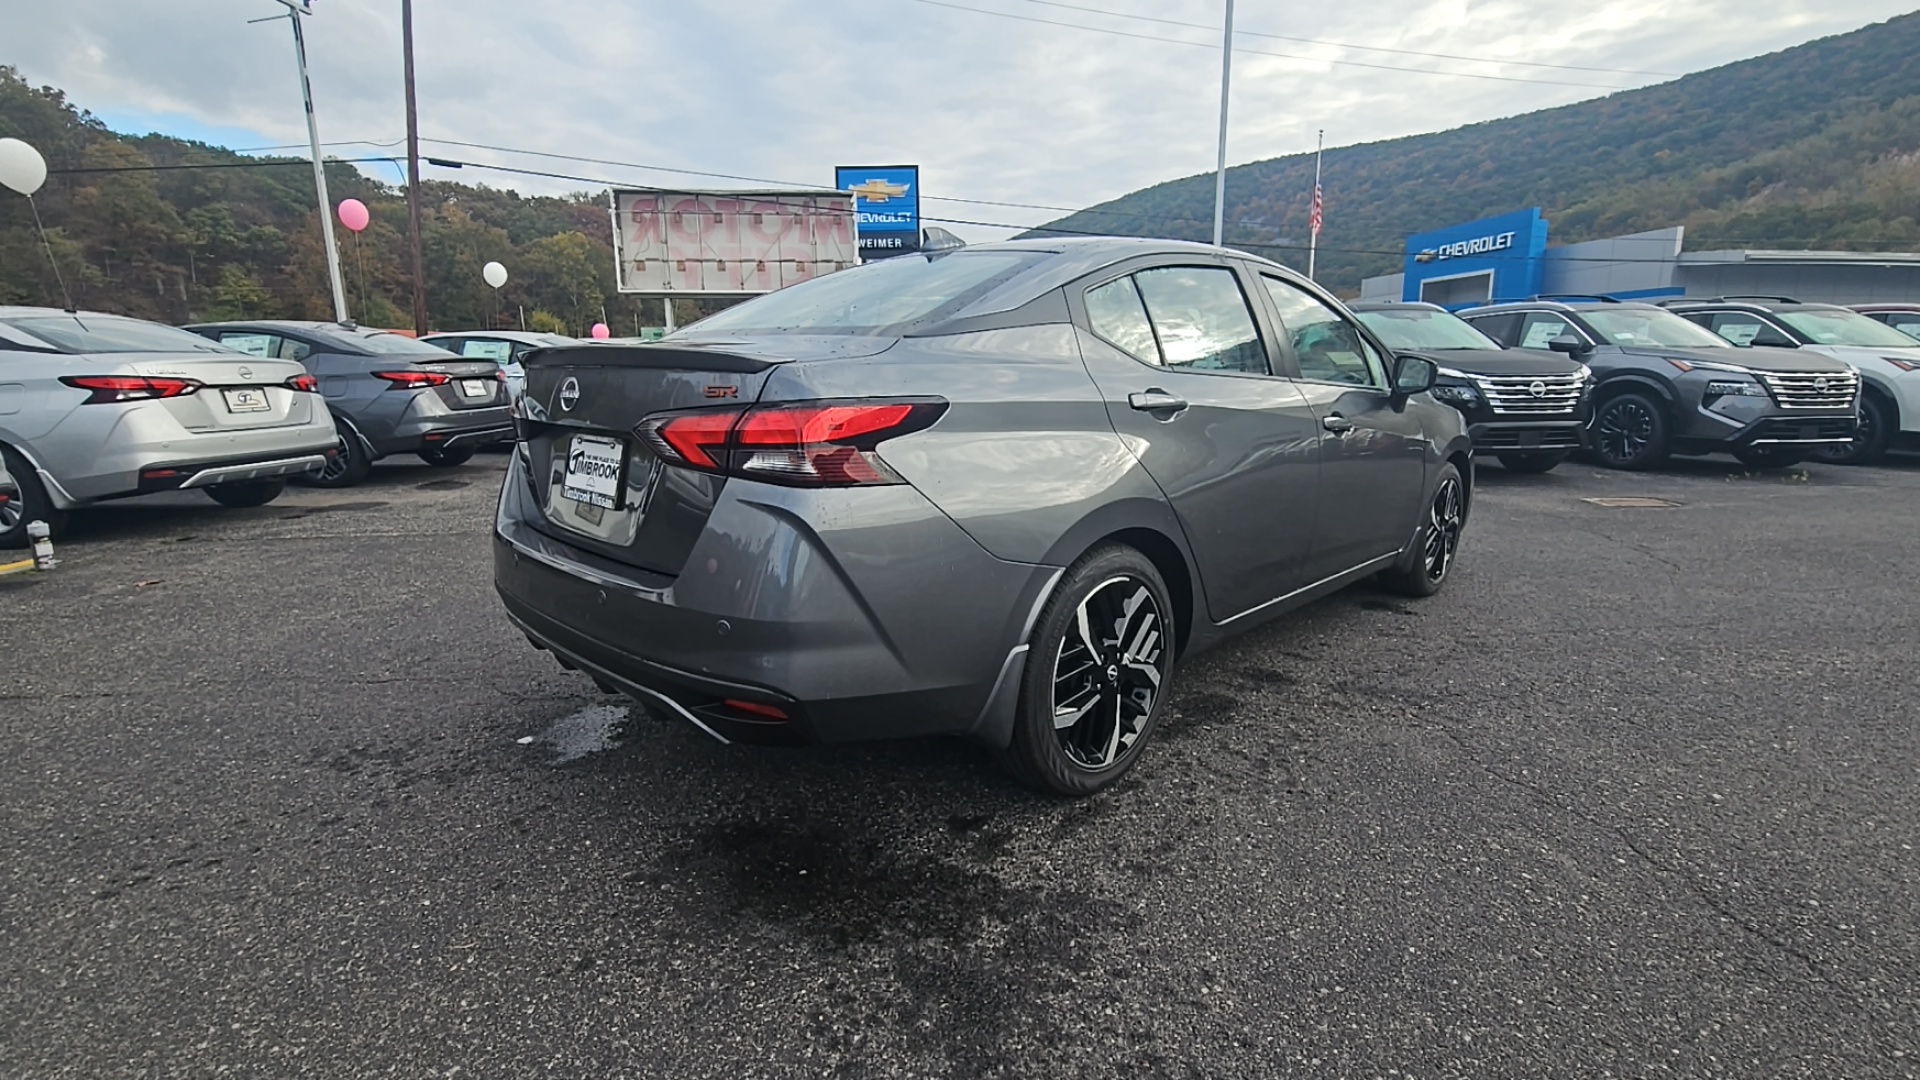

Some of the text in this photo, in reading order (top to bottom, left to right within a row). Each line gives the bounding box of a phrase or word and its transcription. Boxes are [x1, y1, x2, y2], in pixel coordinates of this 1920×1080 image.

[857, 212, 912, 223] EVROLET
[858, 238, 902, 248] WEIMER
[1439, 232, 1515, 259] CHEVROLET
[704, 385, 739, 399] SR
[569, 449, 620, 480] TIMBROOK
[564, 486, 613, 509] Timbrook Nissan
